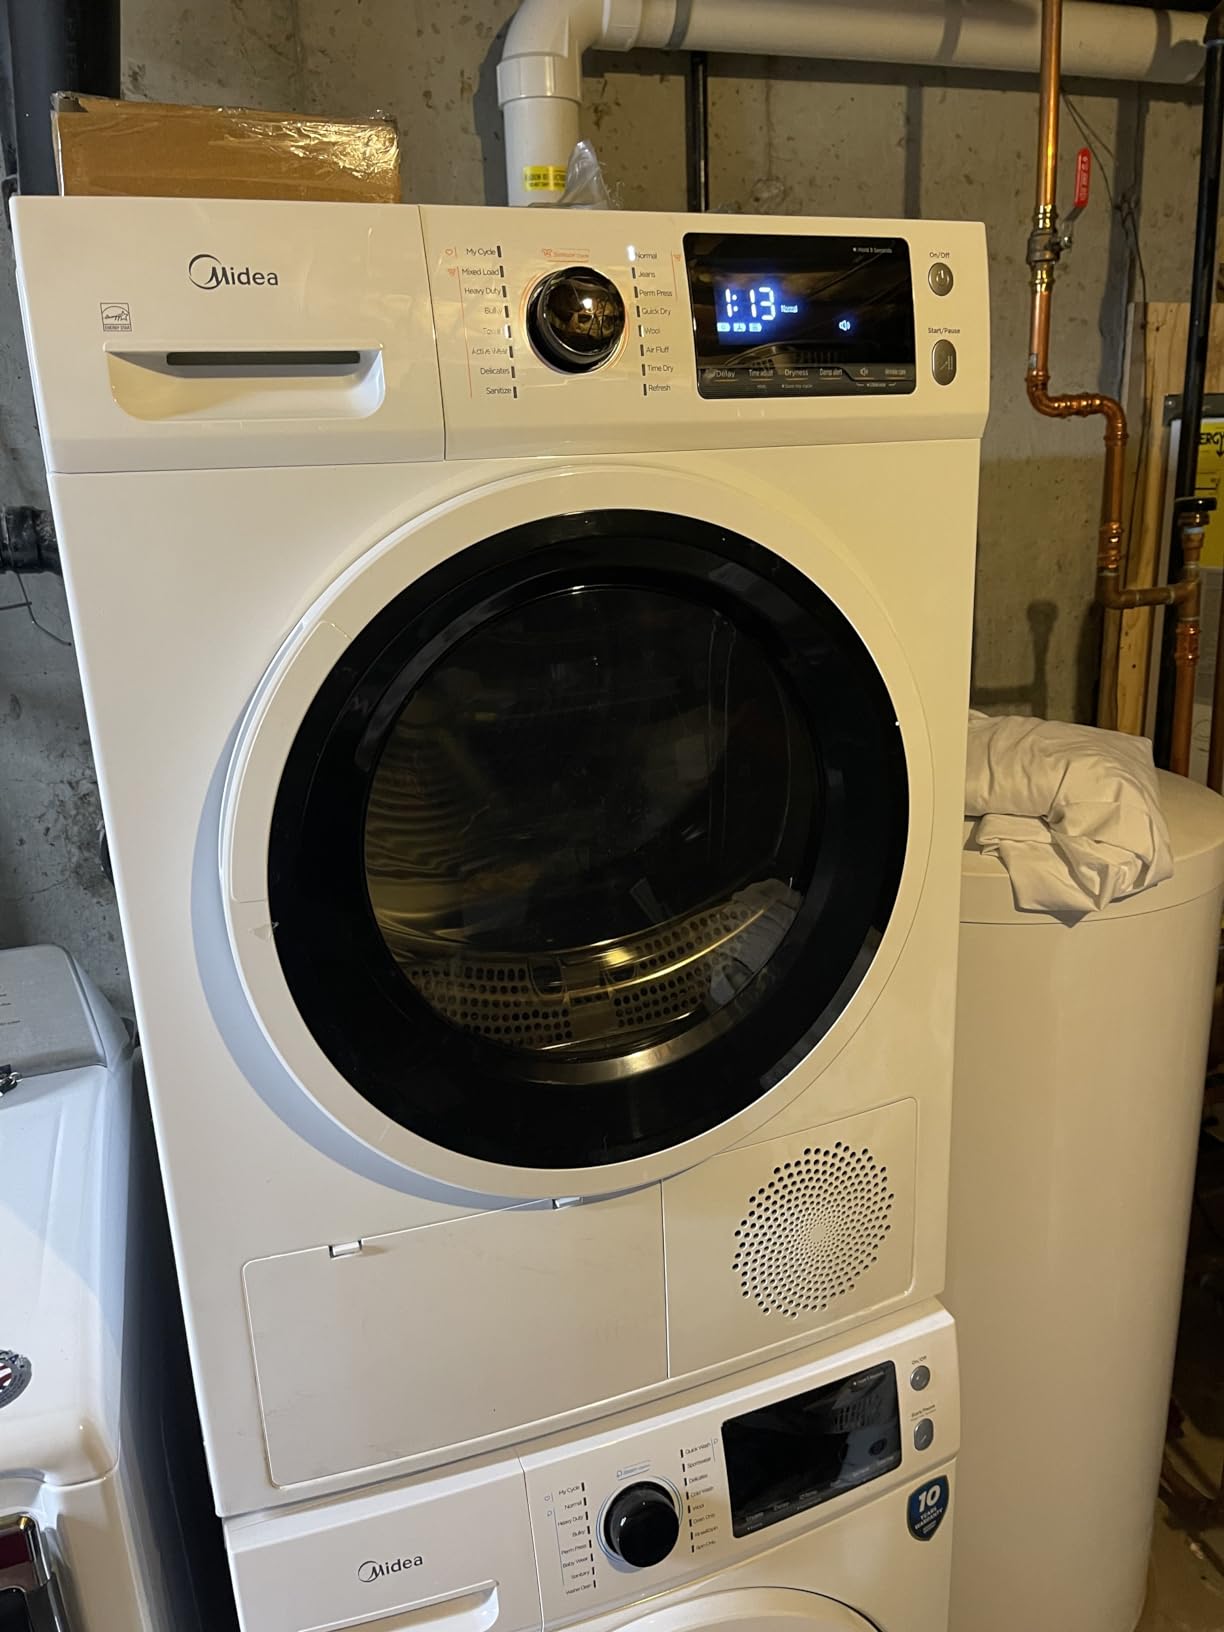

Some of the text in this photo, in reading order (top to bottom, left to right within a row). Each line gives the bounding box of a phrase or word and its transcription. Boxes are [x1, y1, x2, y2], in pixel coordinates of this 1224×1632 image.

[466, 247, 497, 256] My Cycle
[929, 251, 950, 259] On/Off
[188, 254, 279, 290] Midea
[461, 268, 500, 276] Mixed Load
[464, 287, 502, 296] Heavy Duty
[639, 289, 673, 297] Perm Press
[725, 286, 777, 321] 1:13
[484, 306, 503, 315] Buly
[641, 307, 672, 316] Quick Dry
[927, 327, 961, 335] Start/Pause
[479, 367, 510, 375] Delicates
[647, 364, 674, 373] Time Dry
[784, 369, 809, 377] Dryness
[485, 386, 512, 395] Sanitize
[648, 384, 671, 392] Refresh
[918, 1484, 941, 1513] 10
[920, 1505, 937, 1520] YEARS
[914, 1507, 944, 1530] WARRANTY
[358, 1556, 423, 1583] Midea
